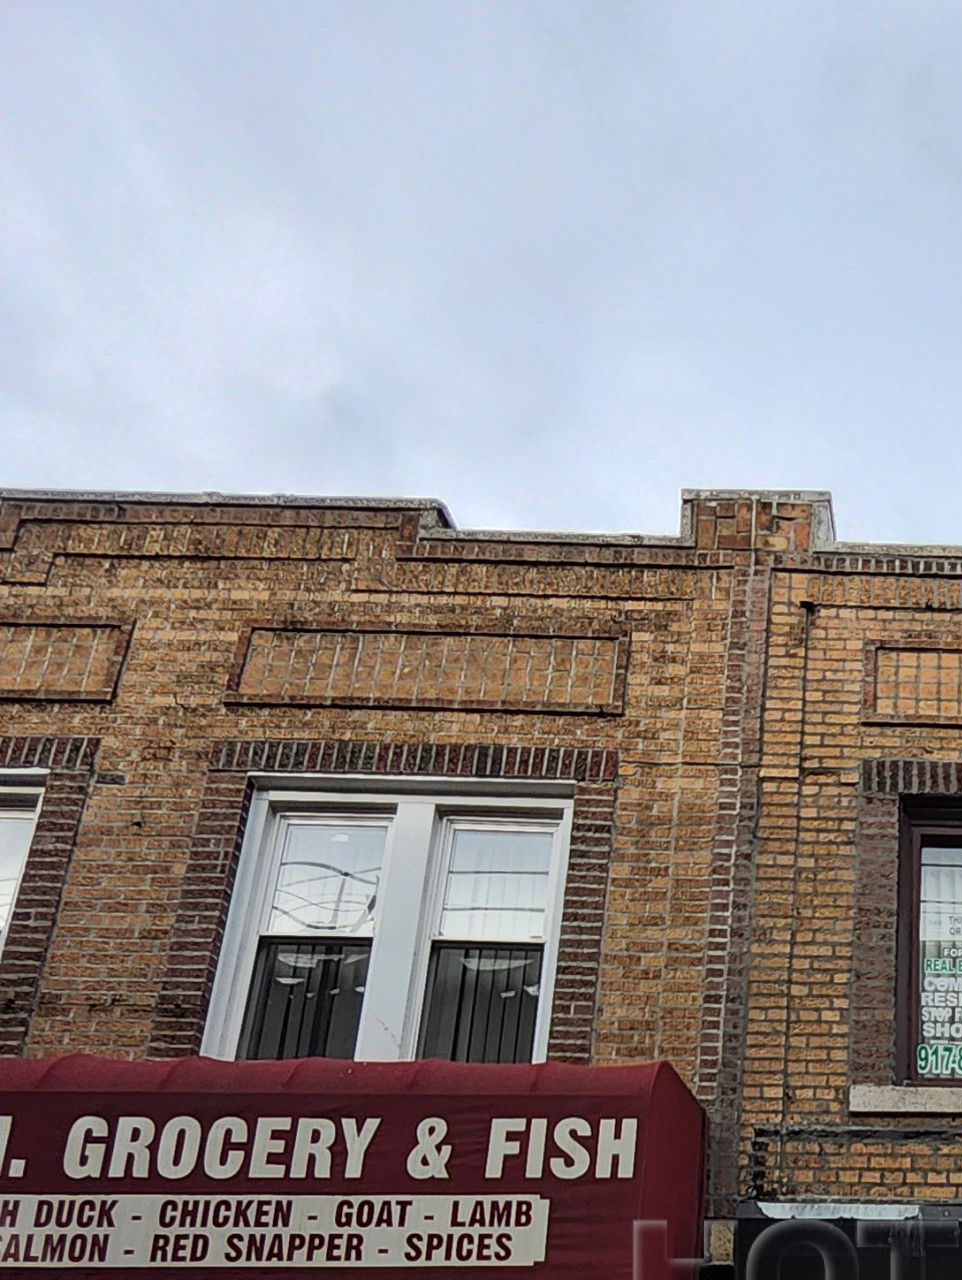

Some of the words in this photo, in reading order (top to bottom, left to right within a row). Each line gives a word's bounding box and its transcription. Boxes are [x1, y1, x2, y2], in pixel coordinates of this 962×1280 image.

[925, 959, 956, 972] REAL
[63, 1116, 381, 1179] GROCERY
[406, 1117, 452, 1179] &
[485, 1117, 637, 1179] FISH
[34, 1200, 118, 1228] DUCK
[159, 1200, 293, 1228] CHICKEN
[335, 1200, 412, 1228] GOAT
[450, 1200, 533, 1228] LAMB
[0, 1233, 110, 1262] ALMON
[150, 1233, 210, 1262] RED
[224, 1232, 364, 1262] SNAPPER
[404, 1232, 513, 1262] SPICES
